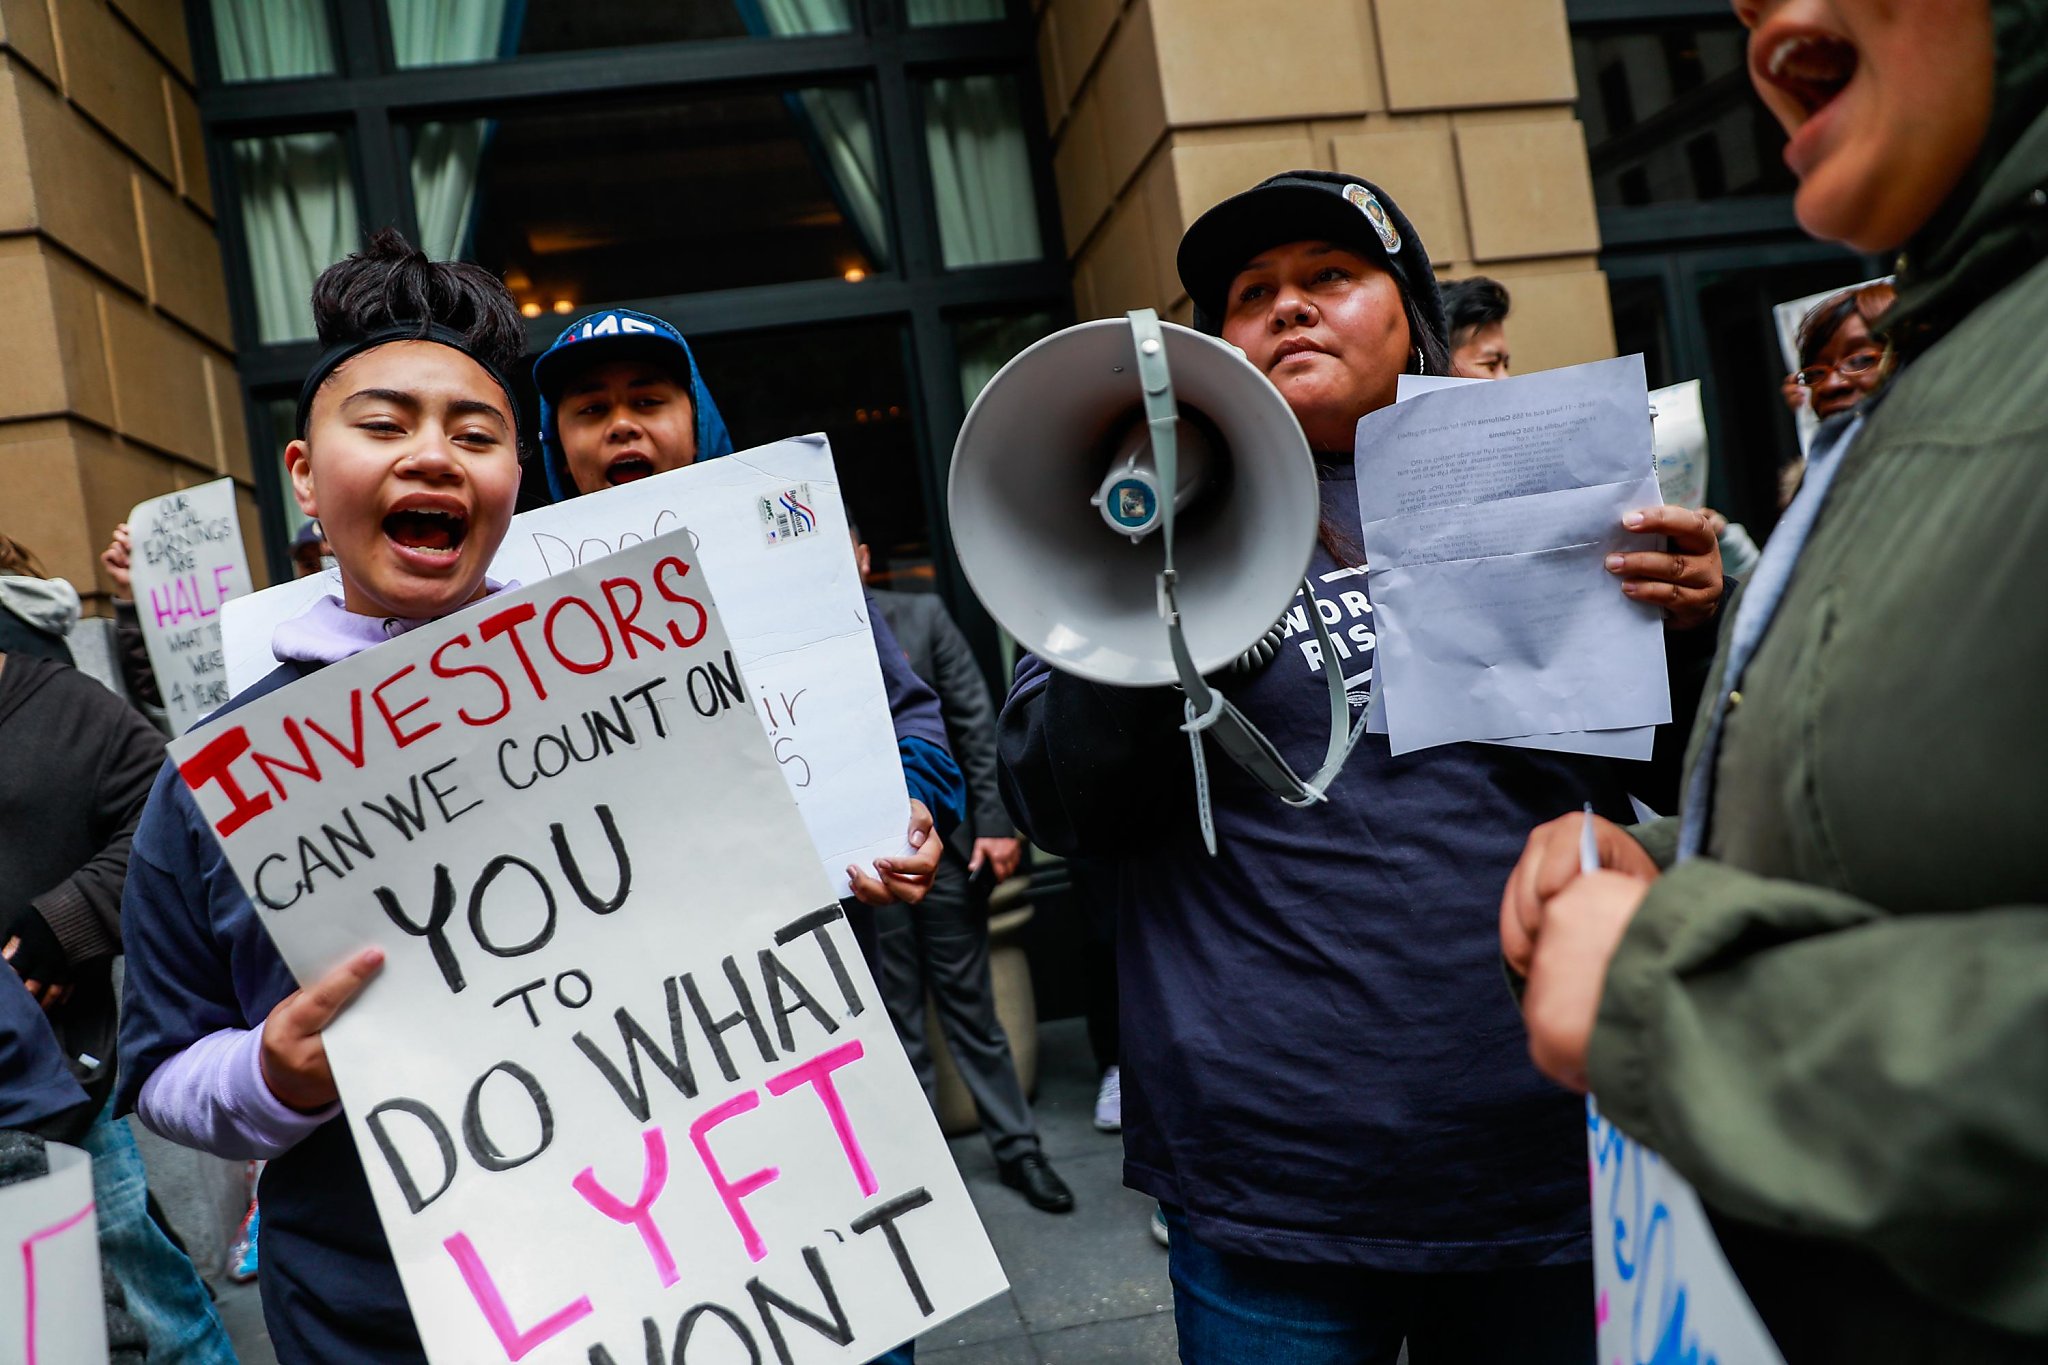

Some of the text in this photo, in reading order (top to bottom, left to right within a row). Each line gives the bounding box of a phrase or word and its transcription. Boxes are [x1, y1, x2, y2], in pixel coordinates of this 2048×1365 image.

[151, 564, 233, 628] HALF
[179, 556, 708, 838] INVESTORS
[499, 677, 666, 790] COUNT
[687, 650, 746, 717] ON
[374, 804, 632, 994] YOU
[366, 903, 865, 1214] DO WHAT
[493, 968, 593, 1027] TO
[443, 1038, 879, 1362] LYFT
[587, 1186, 933, 1365] ON'T
